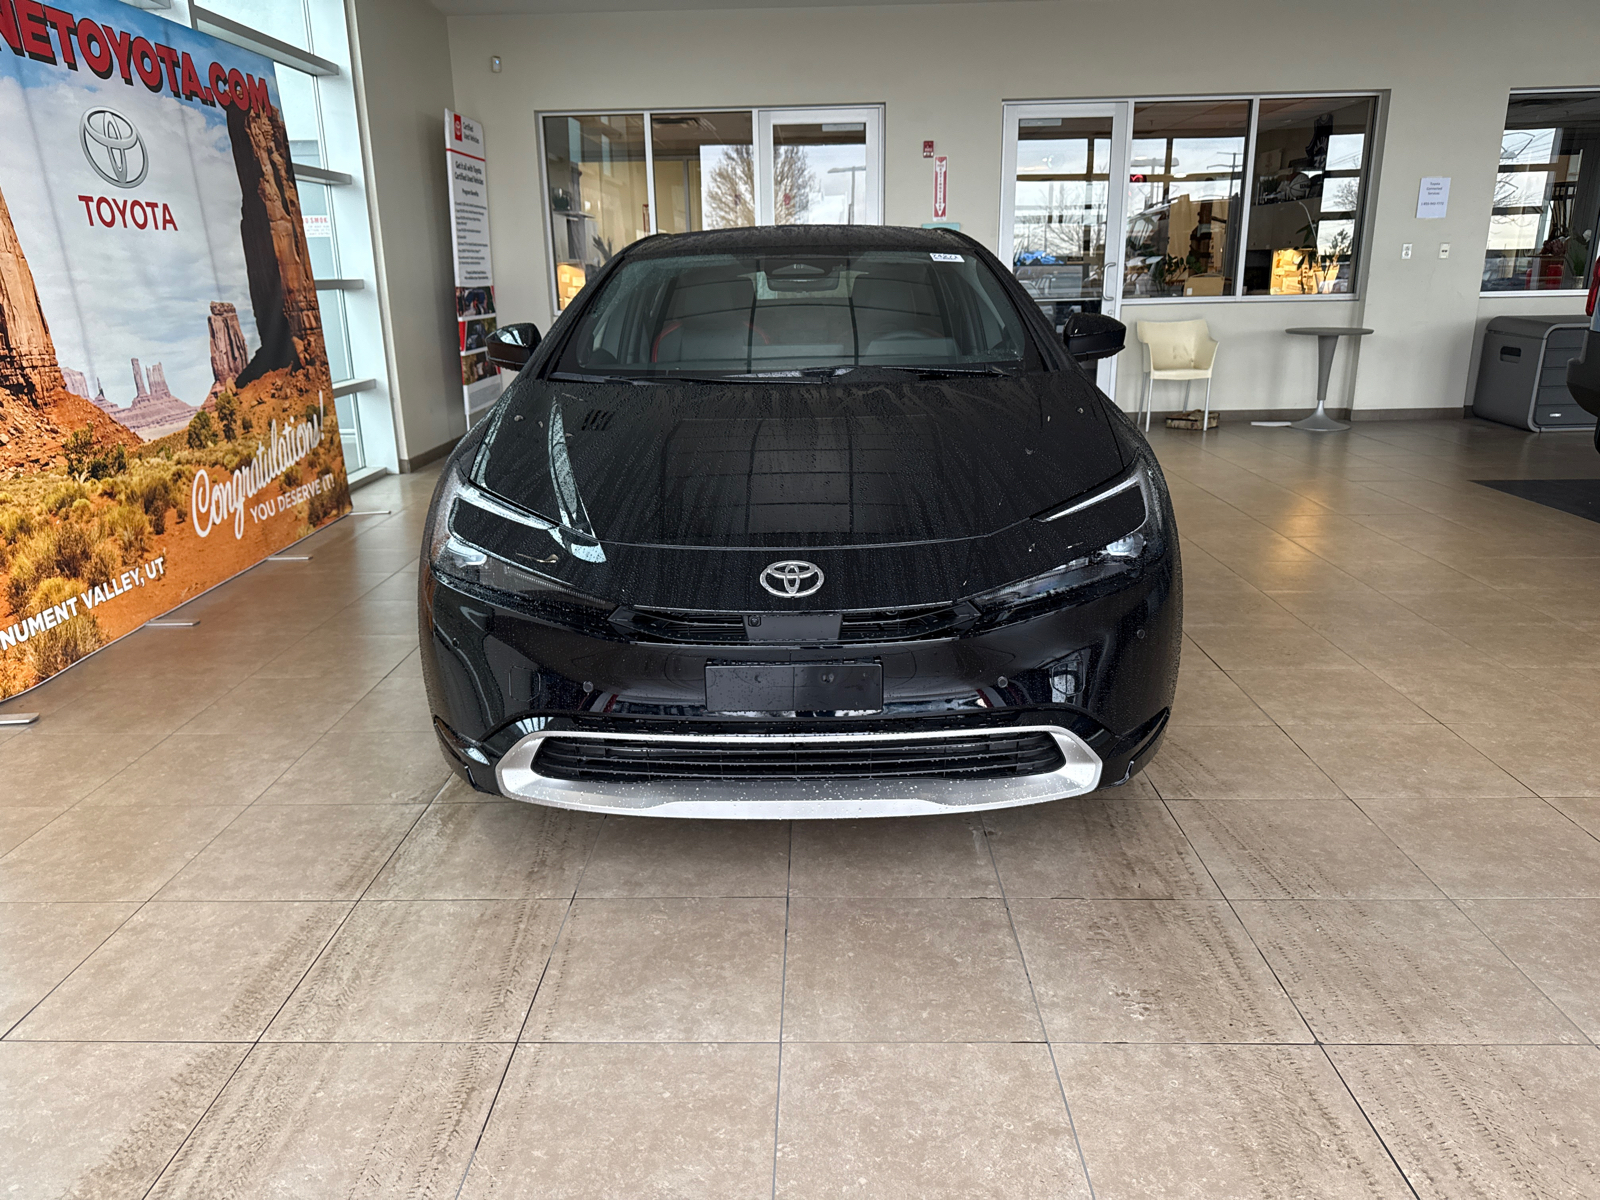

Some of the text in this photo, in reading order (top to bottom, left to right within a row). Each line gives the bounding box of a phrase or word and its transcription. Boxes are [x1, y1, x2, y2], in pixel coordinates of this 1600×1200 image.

[78, 195, 178, 231] TOYOTA
[192, 390, 325, 540] Congratulations!
[250, 473, 336, 524] YOU DESERVE IT!
[0, 557, 165, 651] NUMENT VALLEY, UT
